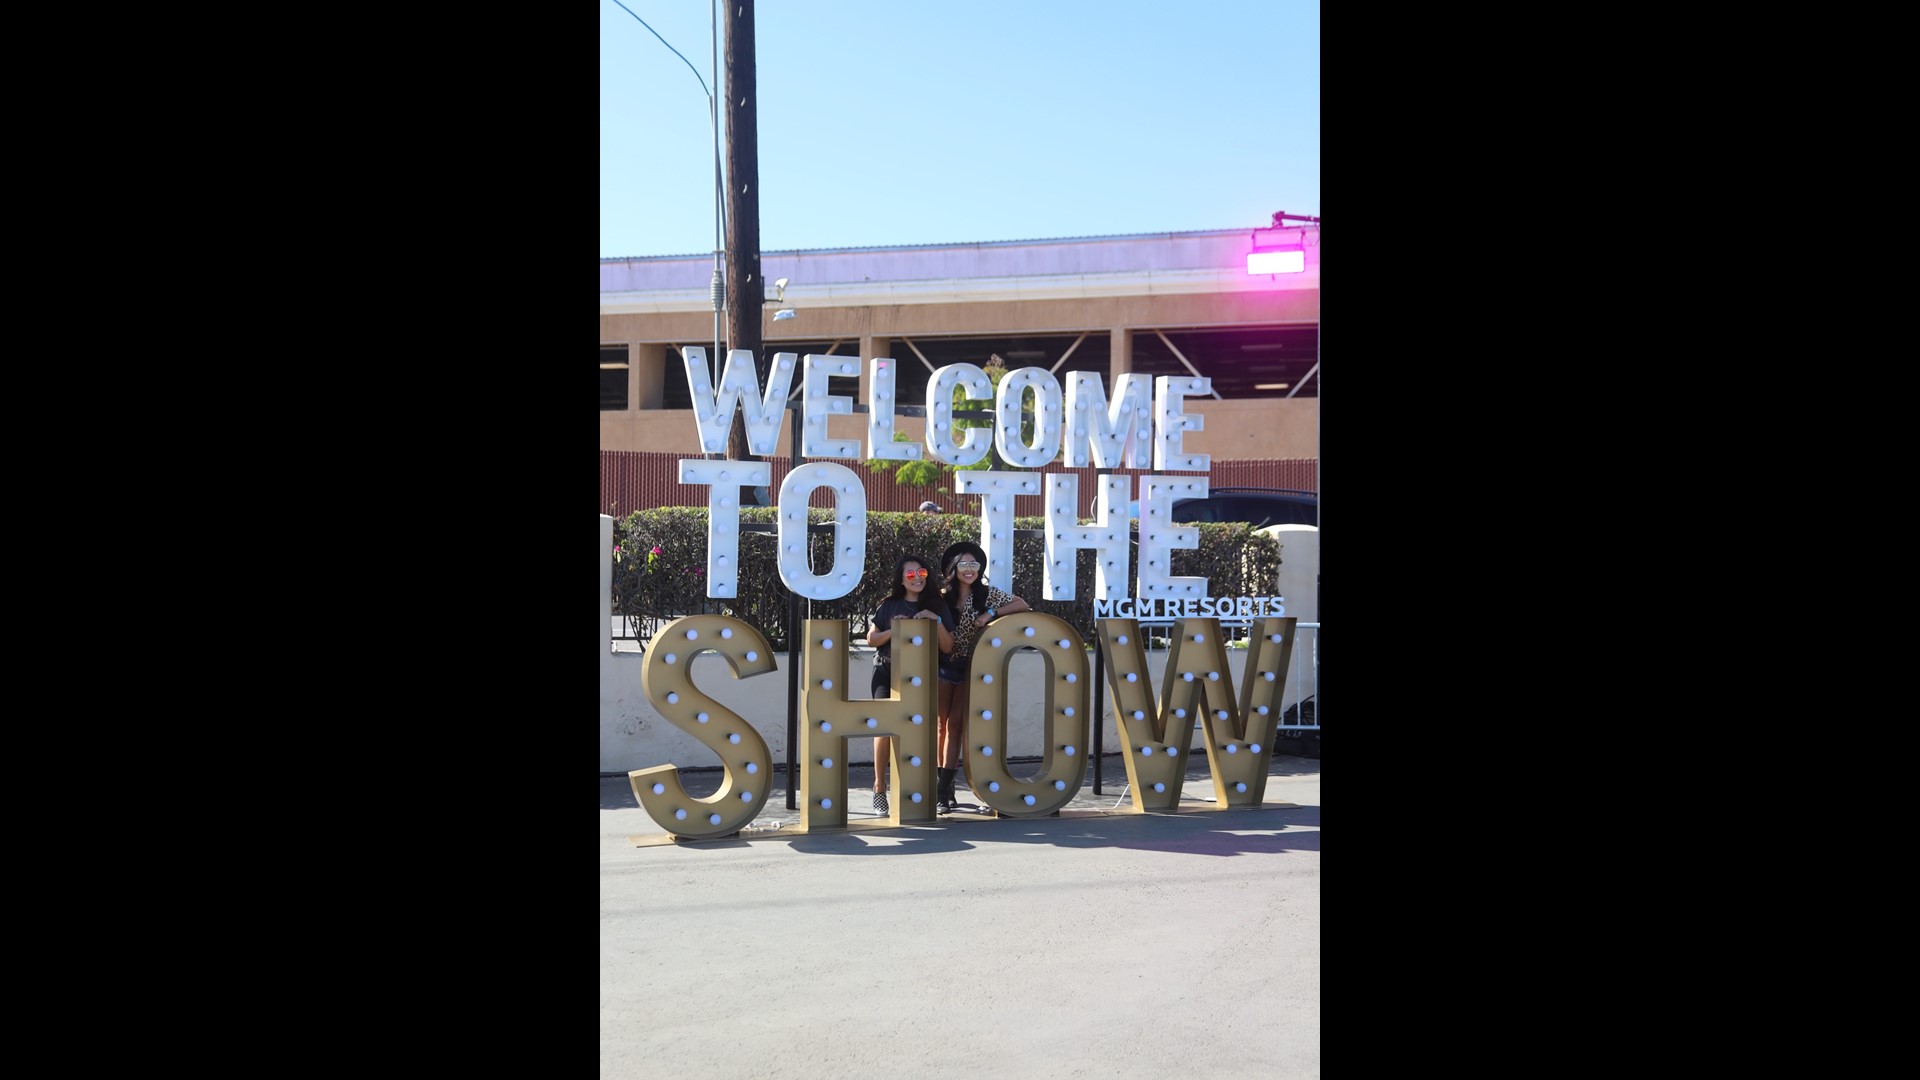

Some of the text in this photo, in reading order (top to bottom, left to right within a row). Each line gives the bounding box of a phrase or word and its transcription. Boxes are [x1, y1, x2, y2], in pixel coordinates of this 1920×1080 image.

[682, 346, 1211, 472] WELCOME
[679, 459, 1209, 601] TO THE
[1094, 597, 1285, 618] MGM RESORTS
[628, 614, 1297, 839] SHOW
